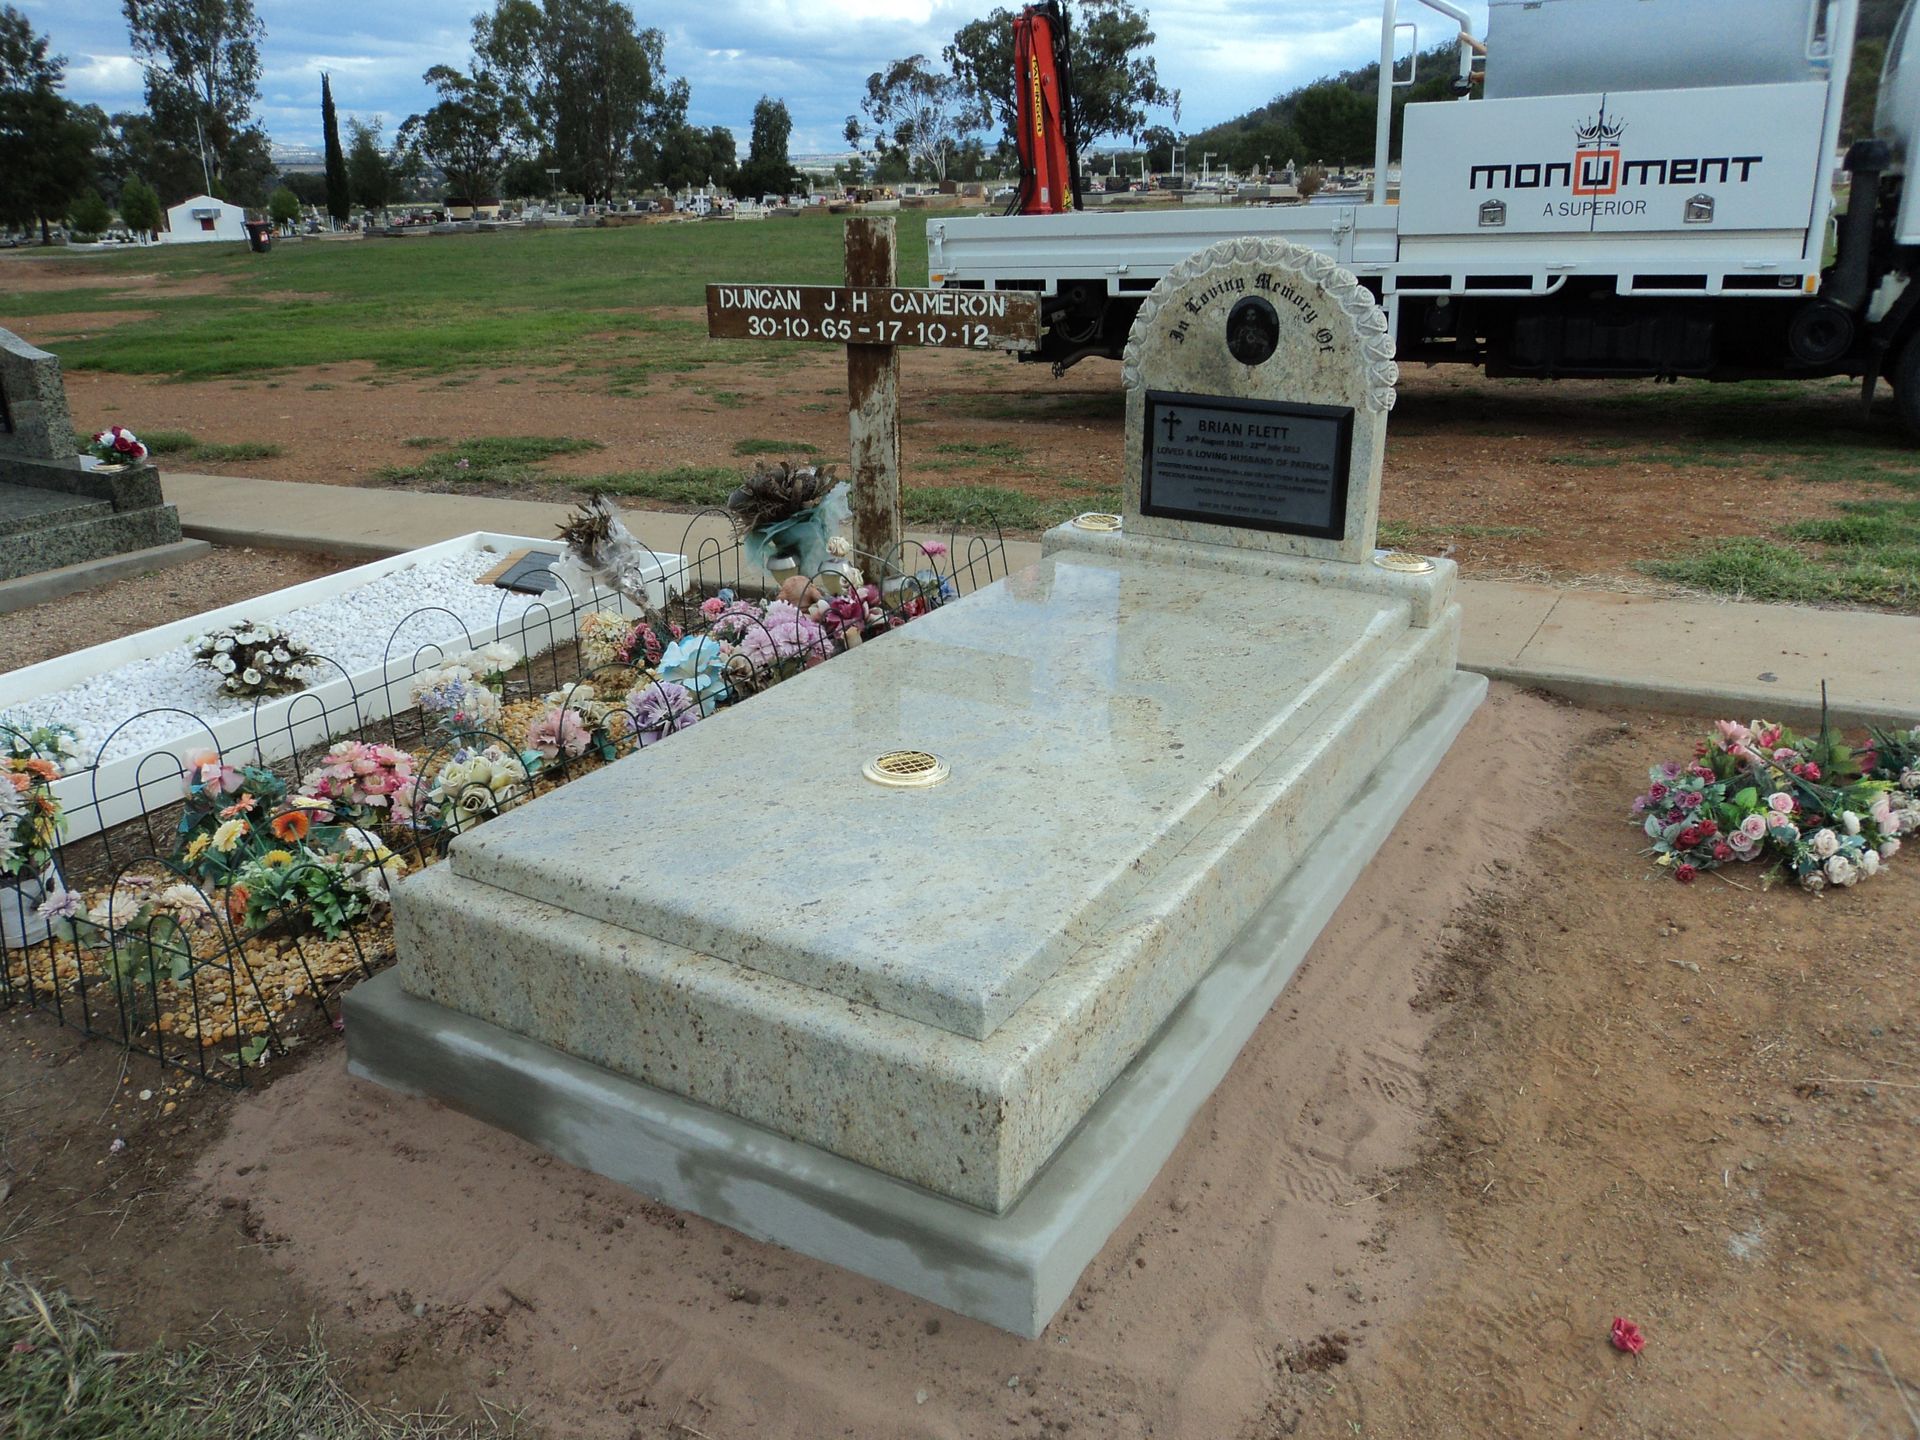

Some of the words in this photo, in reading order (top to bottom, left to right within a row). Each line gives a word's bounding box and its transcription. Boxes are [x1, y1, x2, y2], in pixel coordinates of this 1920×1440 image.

[1542, 202, 1554, 217] A
[1558, 200, 1647, 216] SUPERIOR
[719, 288, 801, 310] DUNCAN
[890, 292, 1005, 317] CAMERON
[1169, 320, 1190, 345] In
[1184, 277, 1245, 316] Loving
[1254, 272, 1318, 324] Memory
[1315, 327, 1335, 354] Of
[1199, 420, 1242, 436] BRIAN
[1248, 424, 1289, 439] FLETT
[1157, 445, 1183, 456] LOVED
[1196, 450, 1227, 461] LOVING
[1230, 453, 1272, 466] HUSBAND
[1291, 460, 1330, 472] PATRICIA
